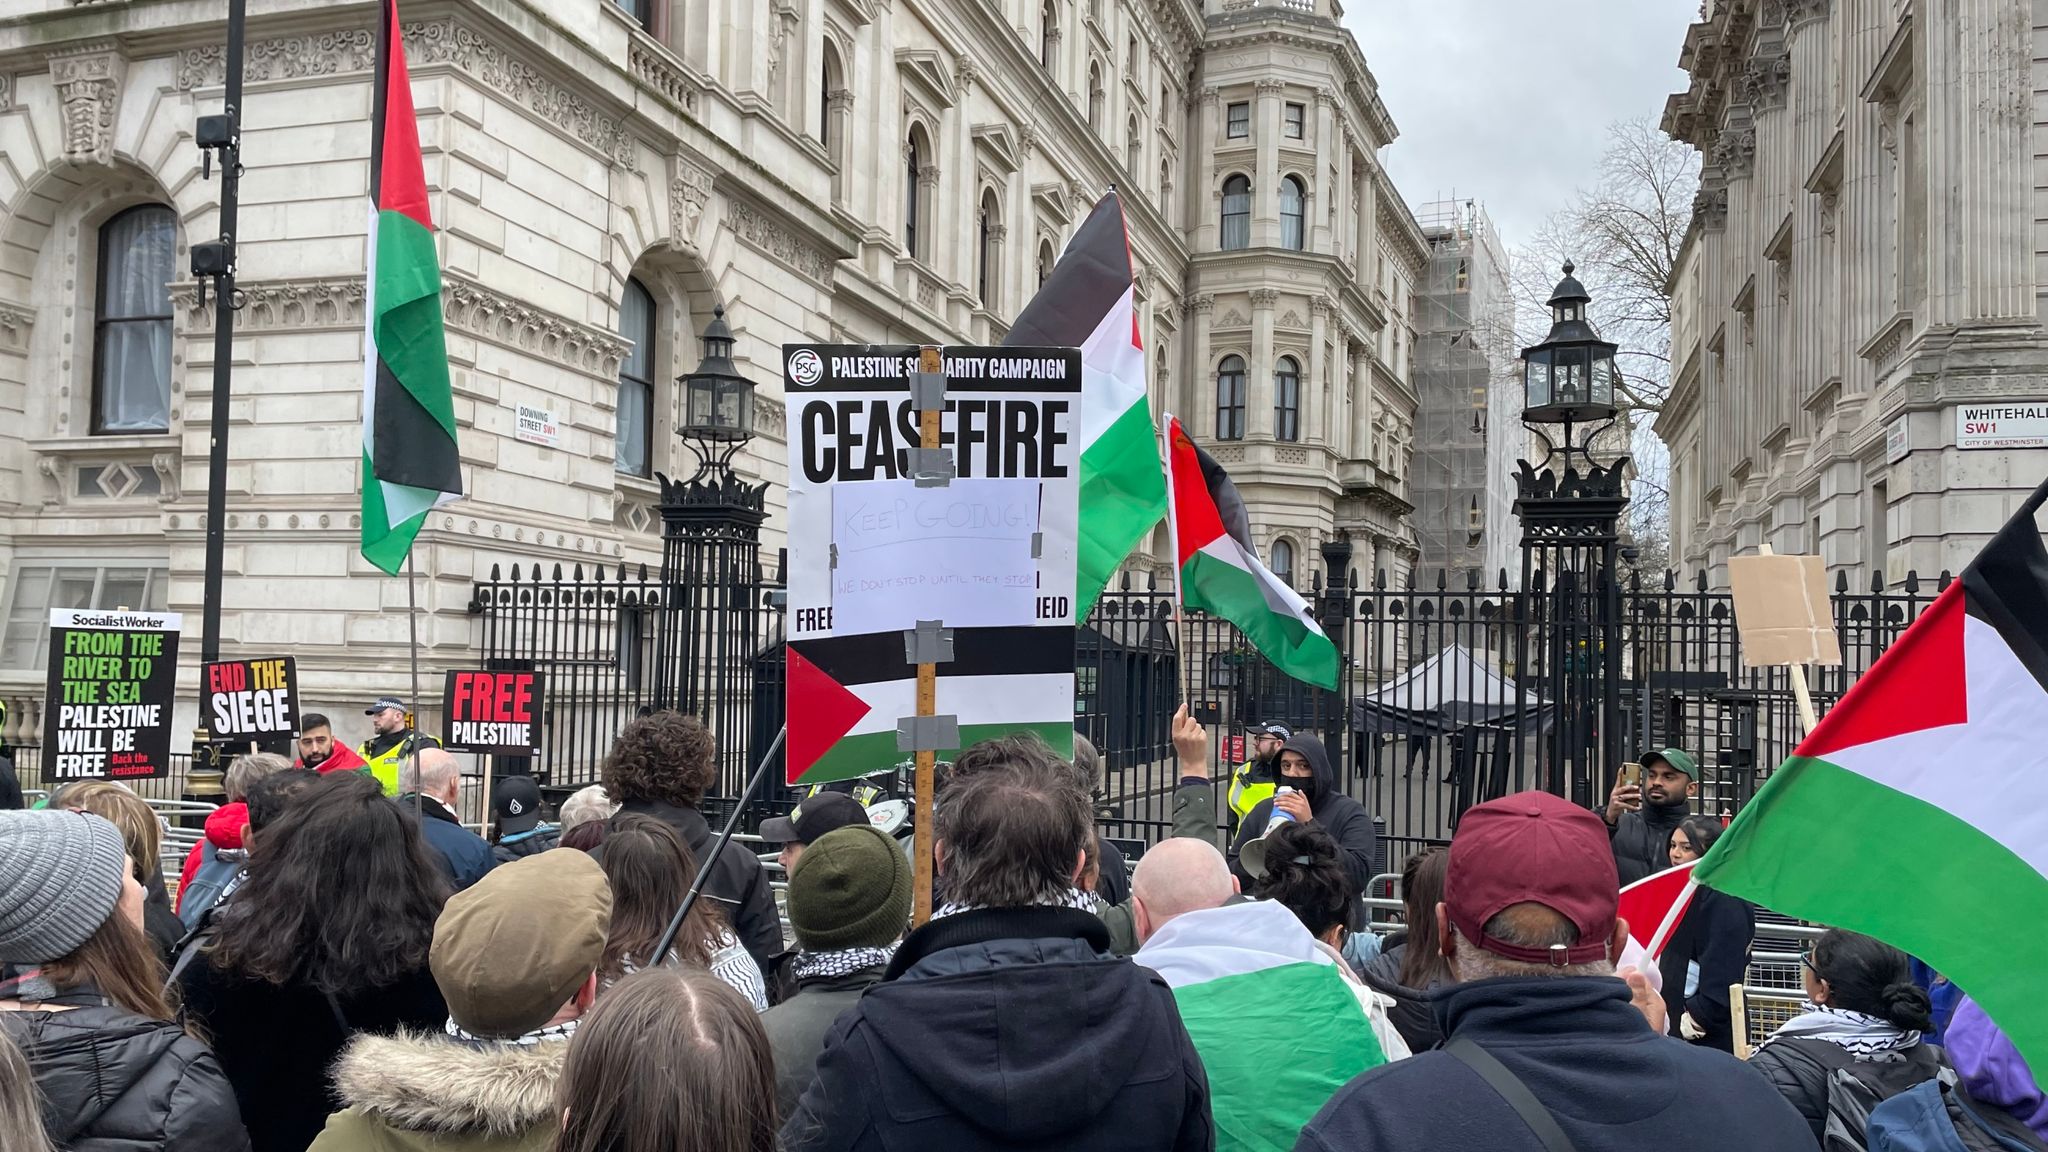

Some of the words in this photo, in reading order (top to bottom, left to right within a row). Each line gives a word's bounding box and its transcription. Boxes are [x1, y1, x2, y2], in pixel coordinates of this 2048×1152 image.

[796, 362, 816, 373] PSC
[832, 357, 902, 378] PALESTINE
[905, 357, 986, 379] SOARITY
[989, 359, 1066, 379] CAMPAIGN
[520, 407, 548, 422] DOWNING
[520, 418, 541, 432] STREET
[543, 424, 555, 435] SW1
[1965, 422, 1996, 434] SW1
[844, 498, 907, 537] KEEP
[914, 502, 1030, 528] GOING!
[838, 578, 854, 594] WE
[895, 574, 925, 587] STOP
[1003, 575, 1032, 585] STOP
[64, 631, 124, 656] FROM
[129, 634, 164, 656] THE
[63, 656, 122, 680] RIVER
[128, 657, 152, 680] TO
[209, 663, 246, 693] END
[250, 660, 287, 690] THE
[61, 681, 100, 704] THE
[106, 682, 141, 704] SEA
[453, 673, 533, 722] FREE
[59, 704, 161, 729] PALESTINE
[212, 688, 292, 734] SIEGE
[57, 730, 107, 753] WILL
[111, 729, 136, 752] BE
[452, 721, 531, 746] PALESTINE
[55, 754, 107, 778] FREE
[111, 764, 155, 776] resistance
[112, 753, 133, 764] Back
[135, 752, 149, 763] the
